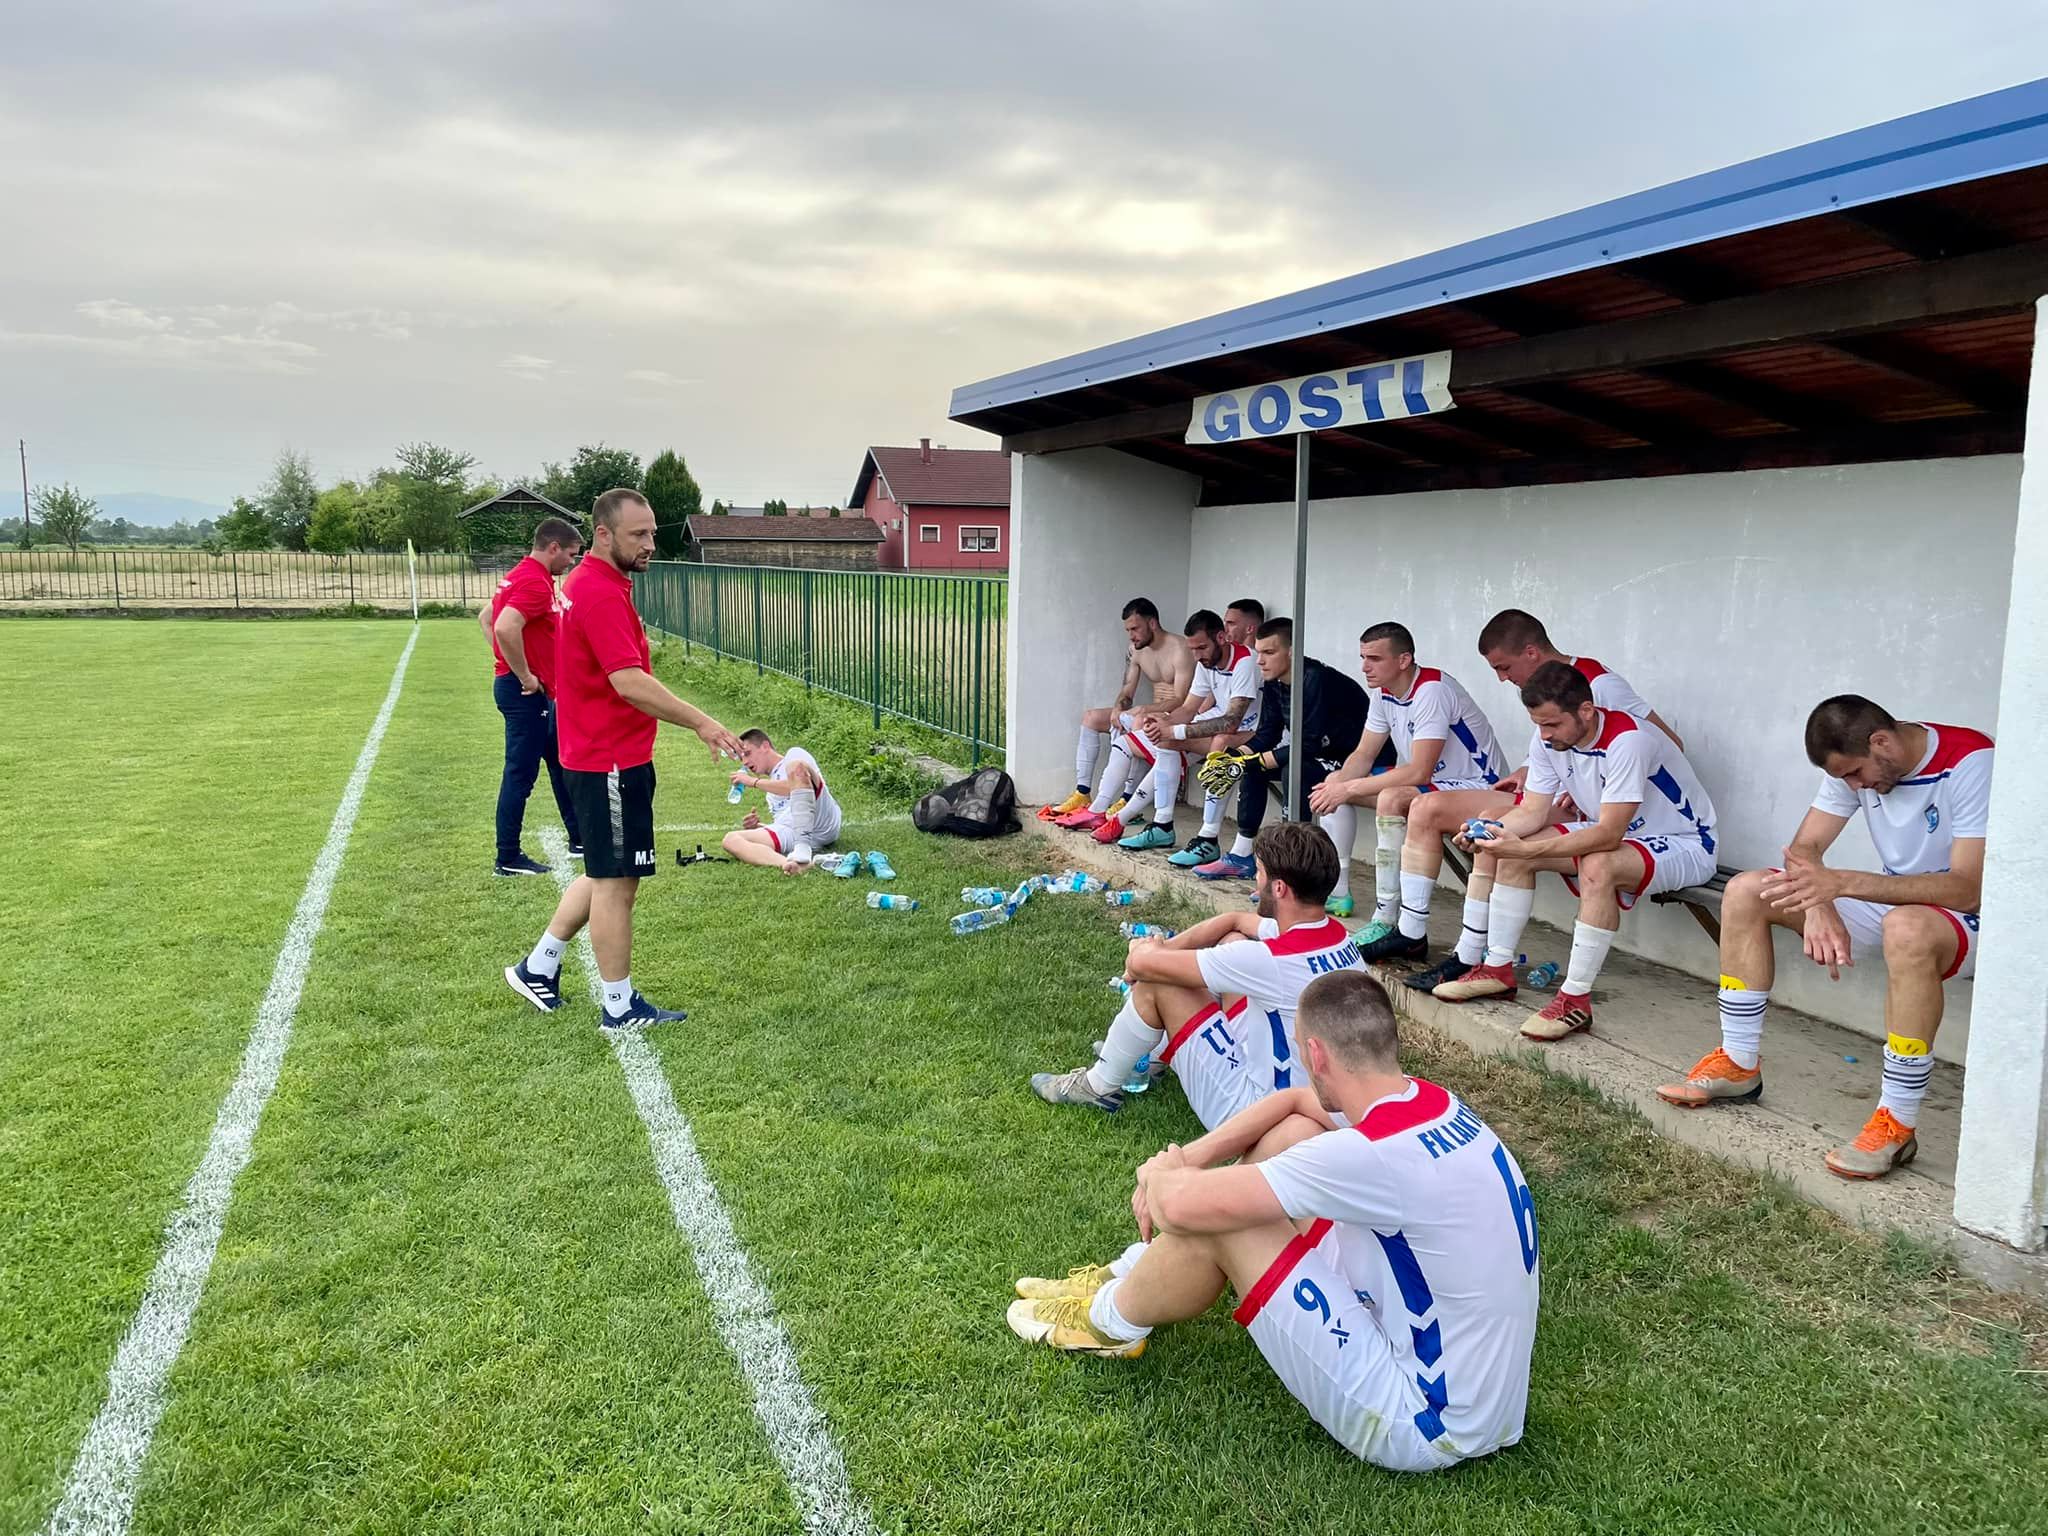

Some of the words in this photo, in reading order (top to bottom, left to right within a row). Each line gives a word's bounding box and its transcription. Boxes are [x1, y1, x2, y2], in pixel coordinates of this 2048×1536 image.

[1203, 359, 1430, 442] GOSTI
[1307, 955, 1334, 975] FK
[1416, 1127, 1457, 1159] FK
[1491, 1142, 1539, 1275] 6
